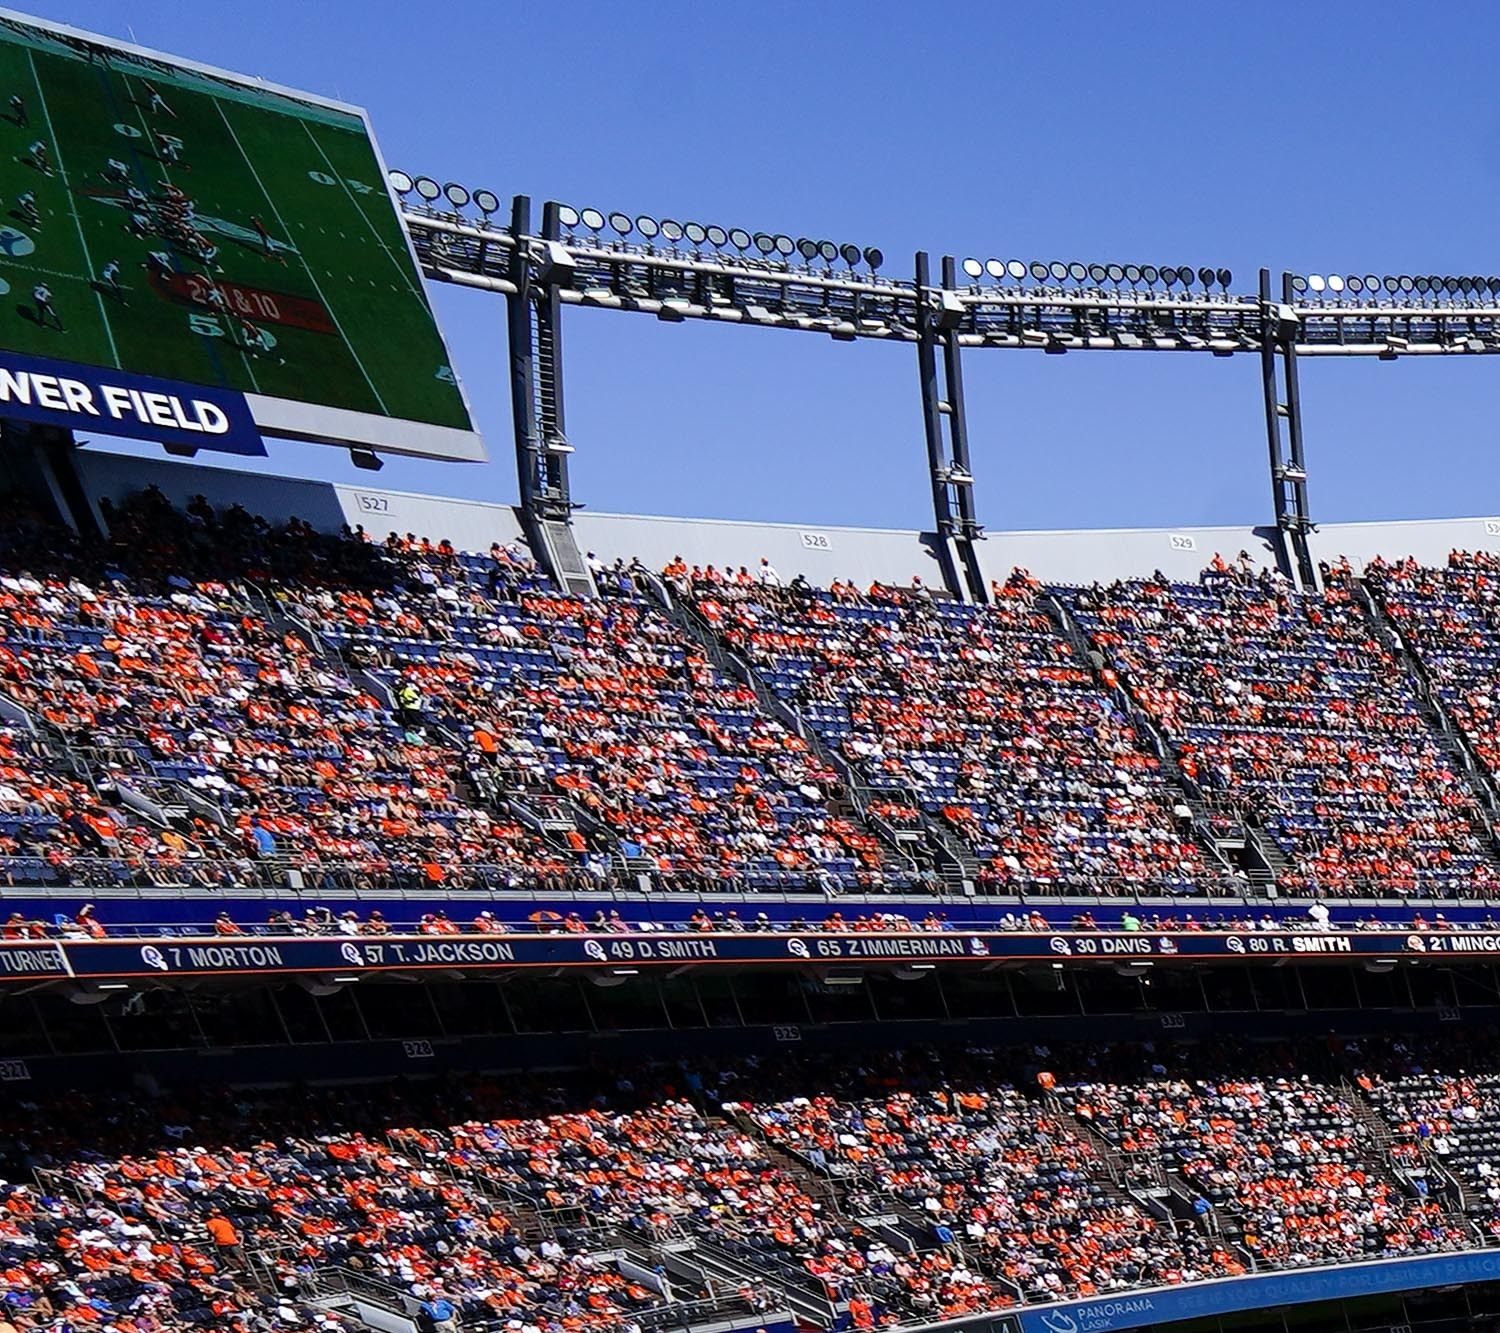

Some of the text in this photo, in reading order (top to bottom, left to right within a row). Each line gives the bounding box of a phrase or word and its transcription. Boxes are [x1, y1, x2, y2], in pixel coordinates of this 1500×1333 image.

[99, 383, 229, 434] FIELD
[366, 942, 515, 964] 57 T. JACKSON
[611, 937, 717, 960] 49 D. SMITH
[817, 938, 963, 957] 65 ZIMMERMAN
[1076, 937, 1152, 954] 30 DAVIS
[1249, 935, 1351, 952] 80 R. SMITH
[1431, 935, 1446, 950] 21
[2, 948, 65, 972] TURNER
[169, 946, 284, 968] 7 MORTON
[405, 1040, 431, 1056] 328
[1265, 1280, 1335, 1302] QUALIFY
[1373, 1269, 1419, 1289] LASIK
[1077, 1299, 1154, 1321] PANORAMA
[1080, 1317, 1114, 1333] LASIK
